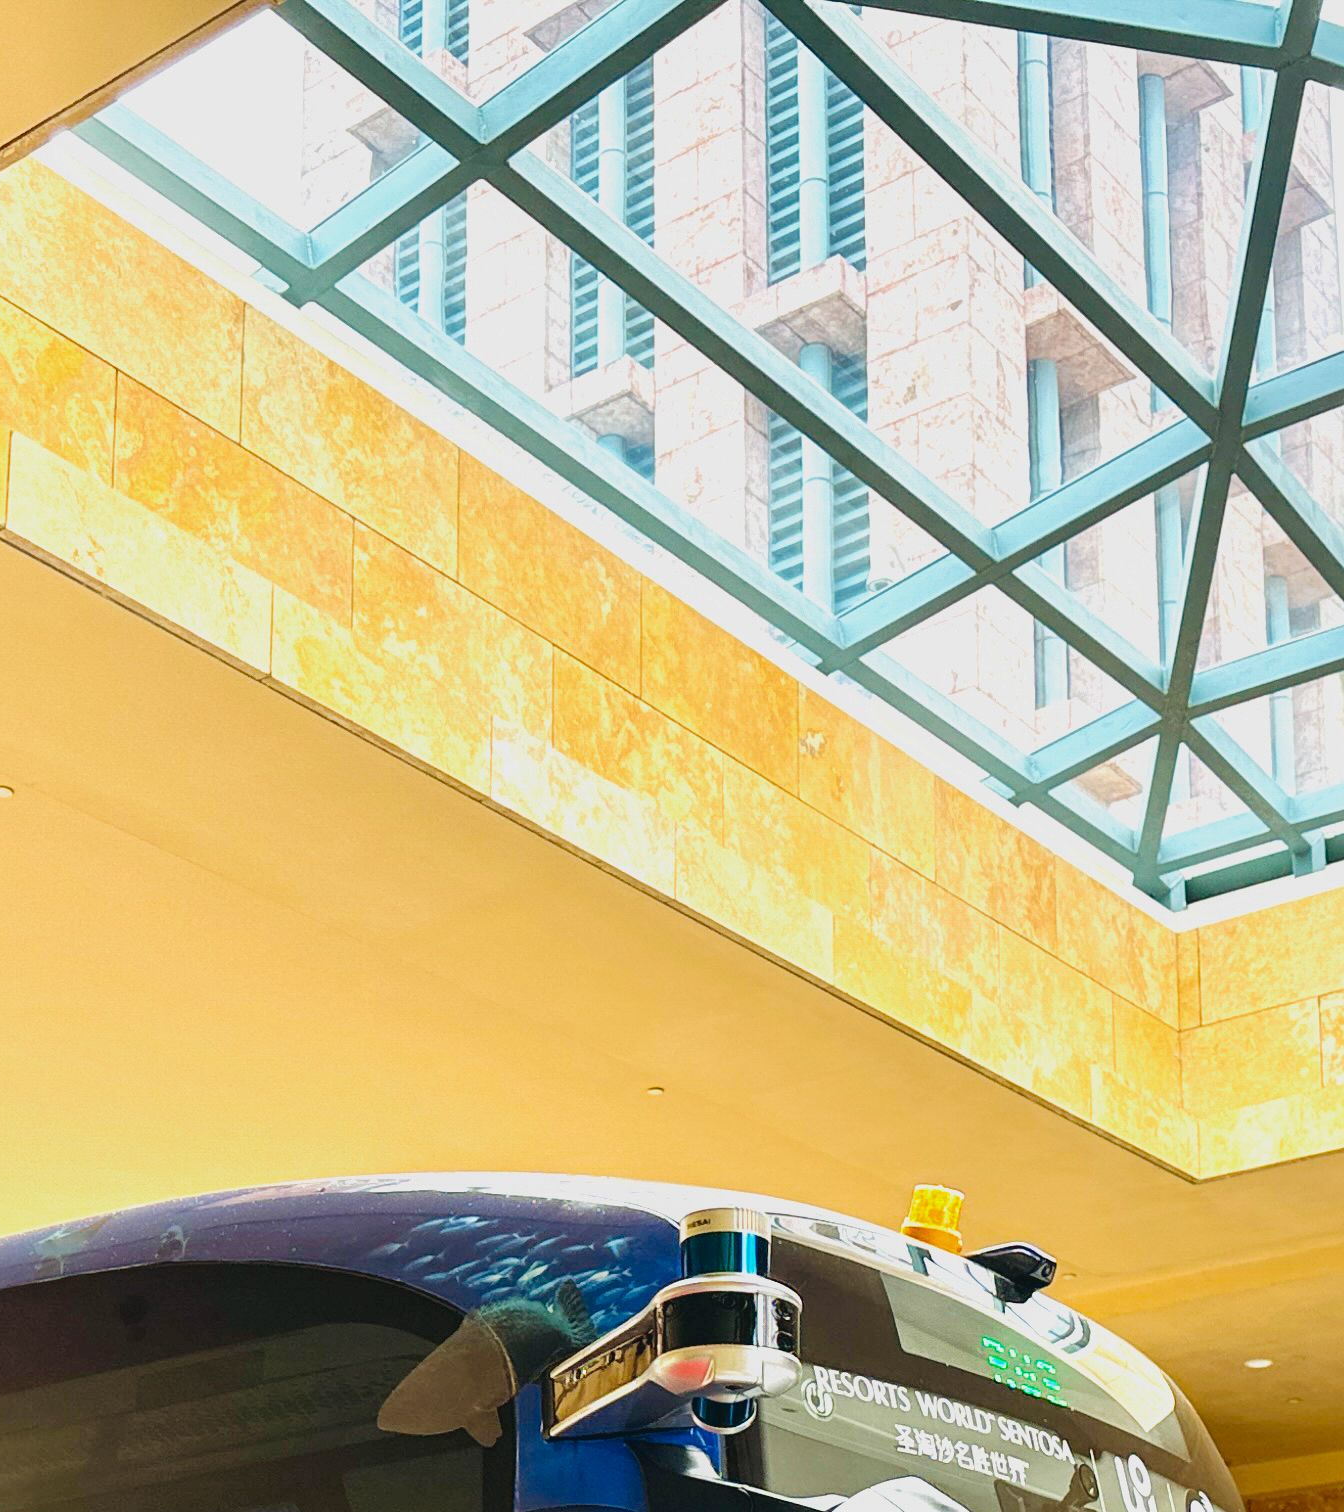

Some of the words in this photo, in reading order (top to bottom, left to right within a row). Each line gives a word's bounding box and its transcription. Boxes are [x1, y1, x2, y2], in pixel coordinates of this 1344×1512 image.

[813, 1365, 911, 1412] RESORTS
[998, 1417, 1075, 1465] SENTOSA
[894, 1424, 1030, 1486] 圣淘沙名胜世界
